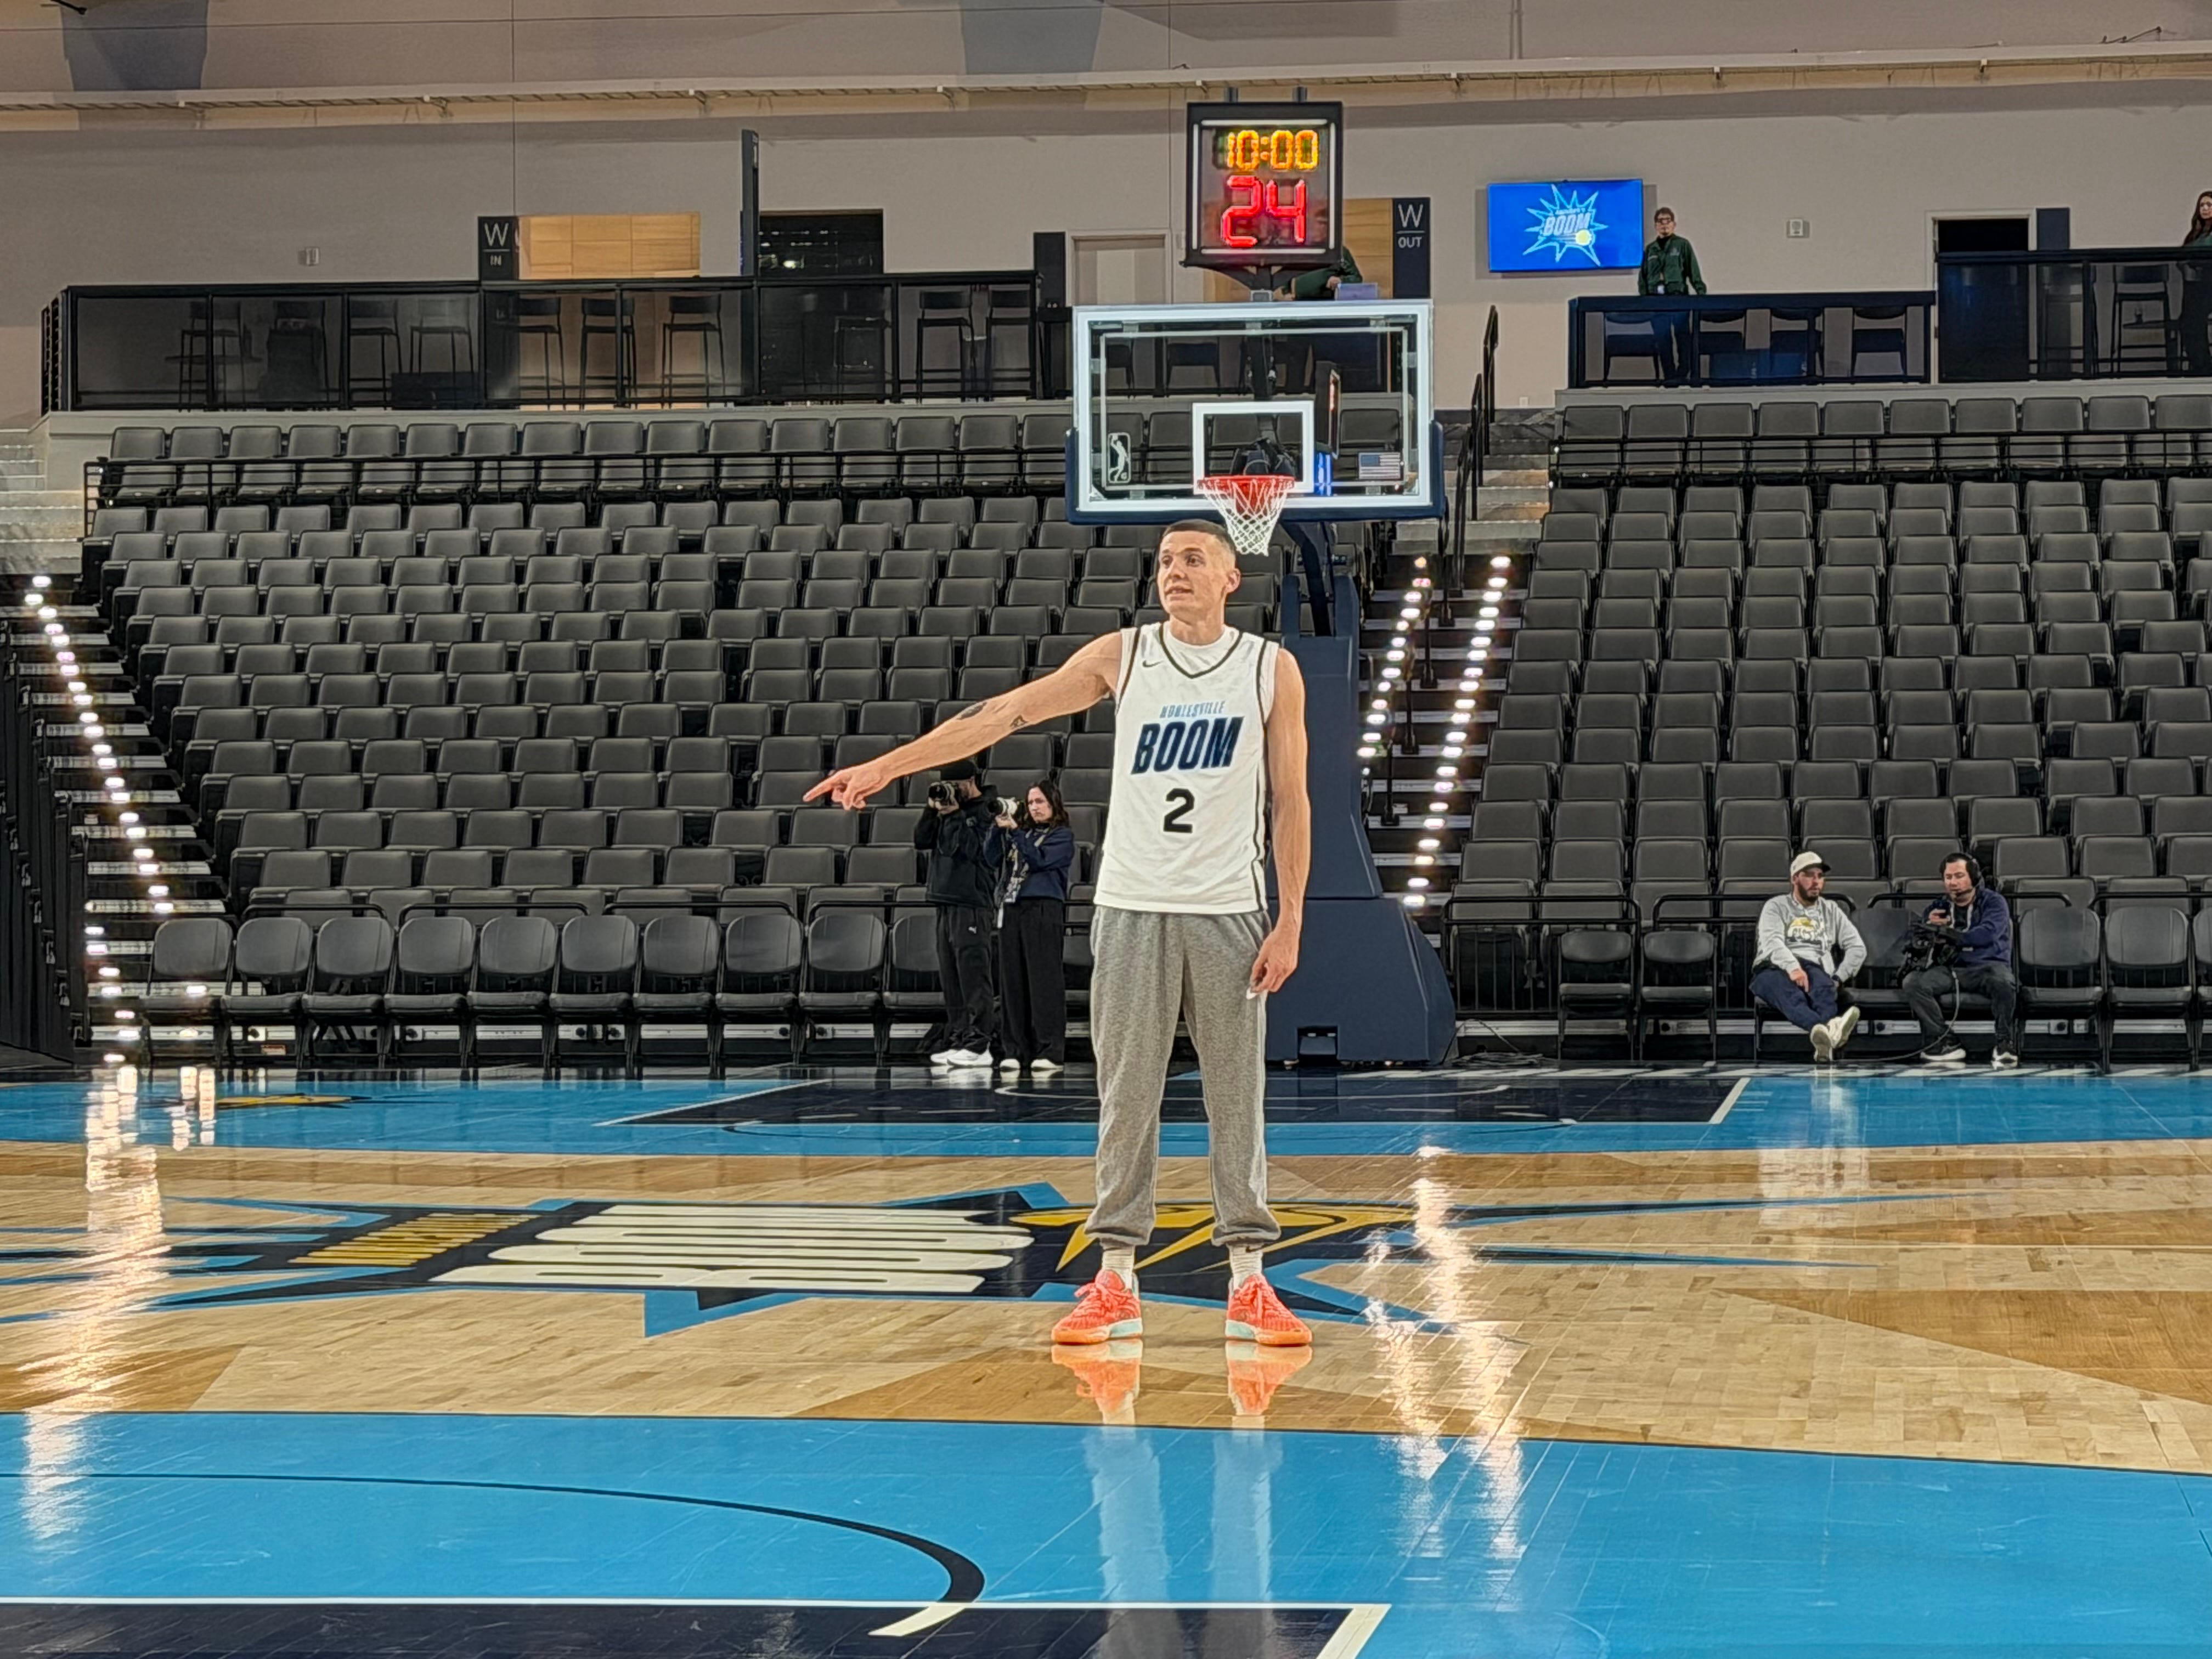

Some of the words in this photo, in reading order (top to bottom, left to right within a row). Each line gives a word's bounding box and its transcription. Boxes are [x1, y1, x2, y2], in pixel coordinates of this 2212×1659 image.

[1227, 129, 1318, 170] 10:00
[1221, 175, 1307, 248] 24
[1398, 204, 1424, 228] W
[484, 222, 509, 246] W
[1543, 212, 1591, 236] BOOM
[1398, 236, 1423, 249] OUT
[489, 255, 502, 266] IN
[1131, 716, 1245, 775] BOOM
[1163, 788, 1195, 834] 2
